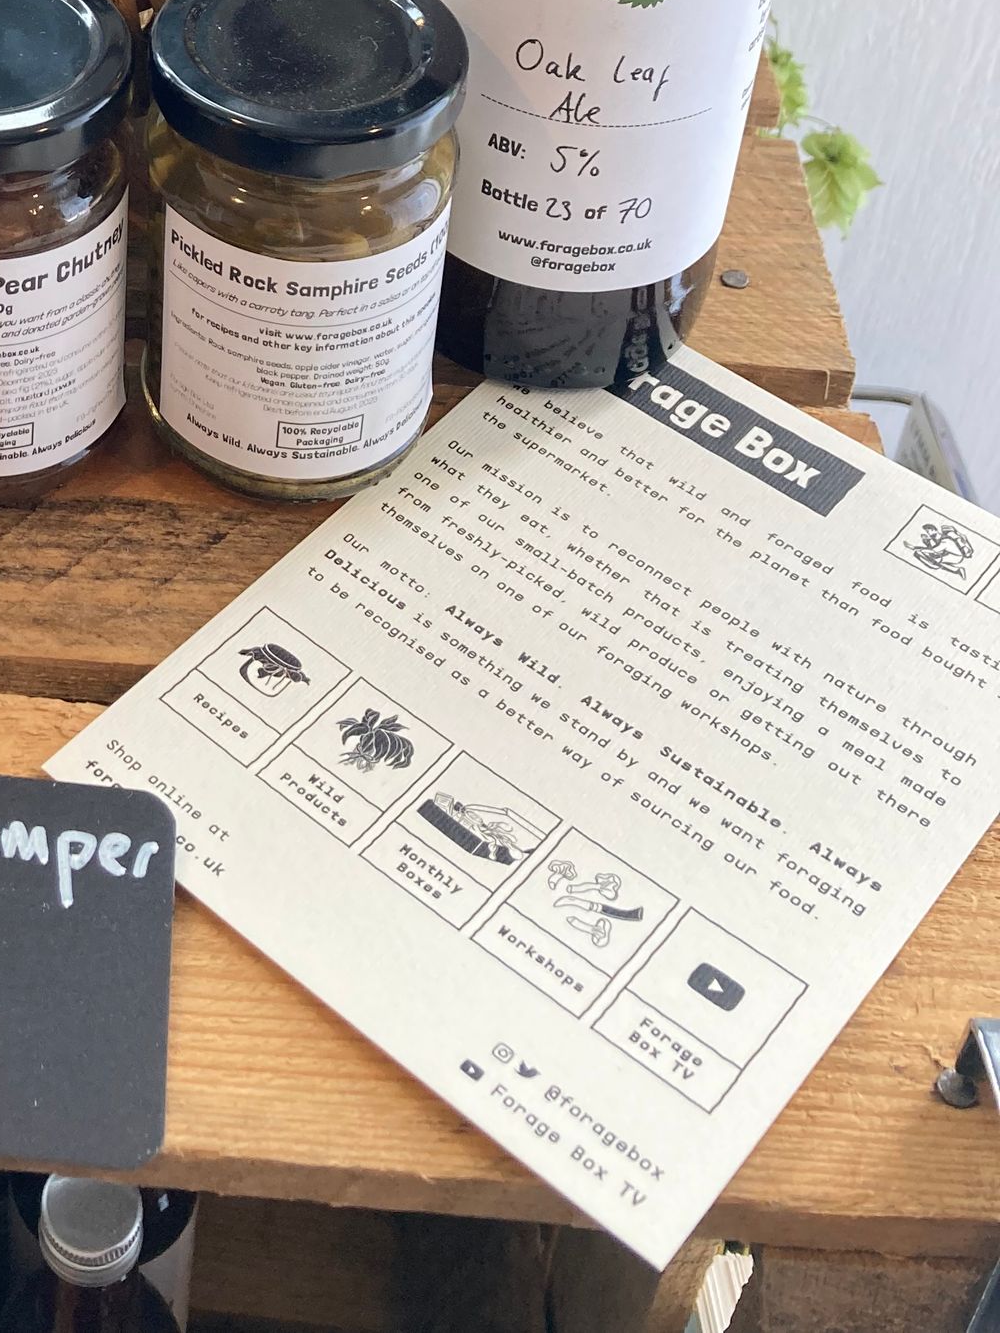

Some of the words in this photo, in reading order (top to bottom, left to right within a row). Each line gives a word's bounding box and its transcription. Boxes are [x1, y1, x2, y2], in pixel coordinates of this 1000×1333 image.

[515, 39, 586, 83] Oak
[549, 91, 602, 125] Ale
[488, 133, 526, 159] ABV:
[550, 145, 601, 178] 5%
[481, 178, 540, 213] Bottle
[545, 197, 573, 222] 23
[584, 205, 608, 221] of
[619, 197, 653, 225] 70
[56, 218, 124, 283] Chutney
[170, 228, 223, 276] Pickled
[229, 266, 278, 294] Rock
[285, 276, 379, 301] Samphire
[385, 250, 428, 284] Seeds
[497, 228, 653, 258] www.foragebox.co.uk
[530, 255, 617, 276] @foragebox
[206, 316, 239, 339] recipes
[241, 332, 259, 345] and
[262, 338, 291, 351] other
[294, 342, 313, 354] key
[315, 333, 374, 352] information
[375, 324, 400, 343] about
[258, 326, 283, 339] visit
[285, 317, 393, 342] www.foragebox.co.uk
[281, 425, 308, 437] 100%
[309, 420, 360, 437] Recyclable
[296, 434, 344, 447] Packaging
[627, 372, 732, 439] rage
[734, 425, 822, 489] Box
[447, 439, 474, 459] Our
[481, 463, 543, 505] mission
[551, 506, 571, 522] is
[581, 524, 600, 540] to
[607, 542, 693, 598] reconnect
[699, 599, 761, 639] people
[770, 640, 812, 670] with
[822, 672, 888, 714] nature
[901, 716, 978, 767] through
[192, 692, 250, 740] Recipes
[323, 548, 407, 611] Delicious
[412, 612, 434, 630] is
[439, 631, 524, 693] something
[529, 692, 552, 710] we
[558, 712, 612, 749] stand
[615, 747, 640, 769] by
[646, 770, 683, 796] and
[688, 796, 711, 815] we
[719, 817, 766, 851] want
[776, 852, 867, 918] foraging
[342, 532, 370, 554] Our
[379, 559, 432, 599] motto:
[444, 604, 504, 648] Always
[517, 651, 563, 690] Wild.
[579, 695, 644, 741] Always
[659, 745, 788, 835] Sustainable.
[808, 841, 883, 894] Always
[105, 738, 143, 772] Shop
[147, 774, 203, 821] online
[208, 823, 231, 843] at
[279, 771, 348, 828] Products
[307, 773, 346, 804] Wild
[395, 861, 443, 900] Boxes
[398, 843, 464, 895] Monthly
[497, 924, 585, 994] Workshops
[628, 1030, 662, 1060] Box
[671, 1059, 695, 1081] TV
[638, 1016, 704, 1068] Forage
[489, 1082, 561, 1145] Forage
[569, 1144, 609, 1182] Box
[619, 1179, 648, 1208] TV
[543, 1084, 666, 1182] @foragebox
